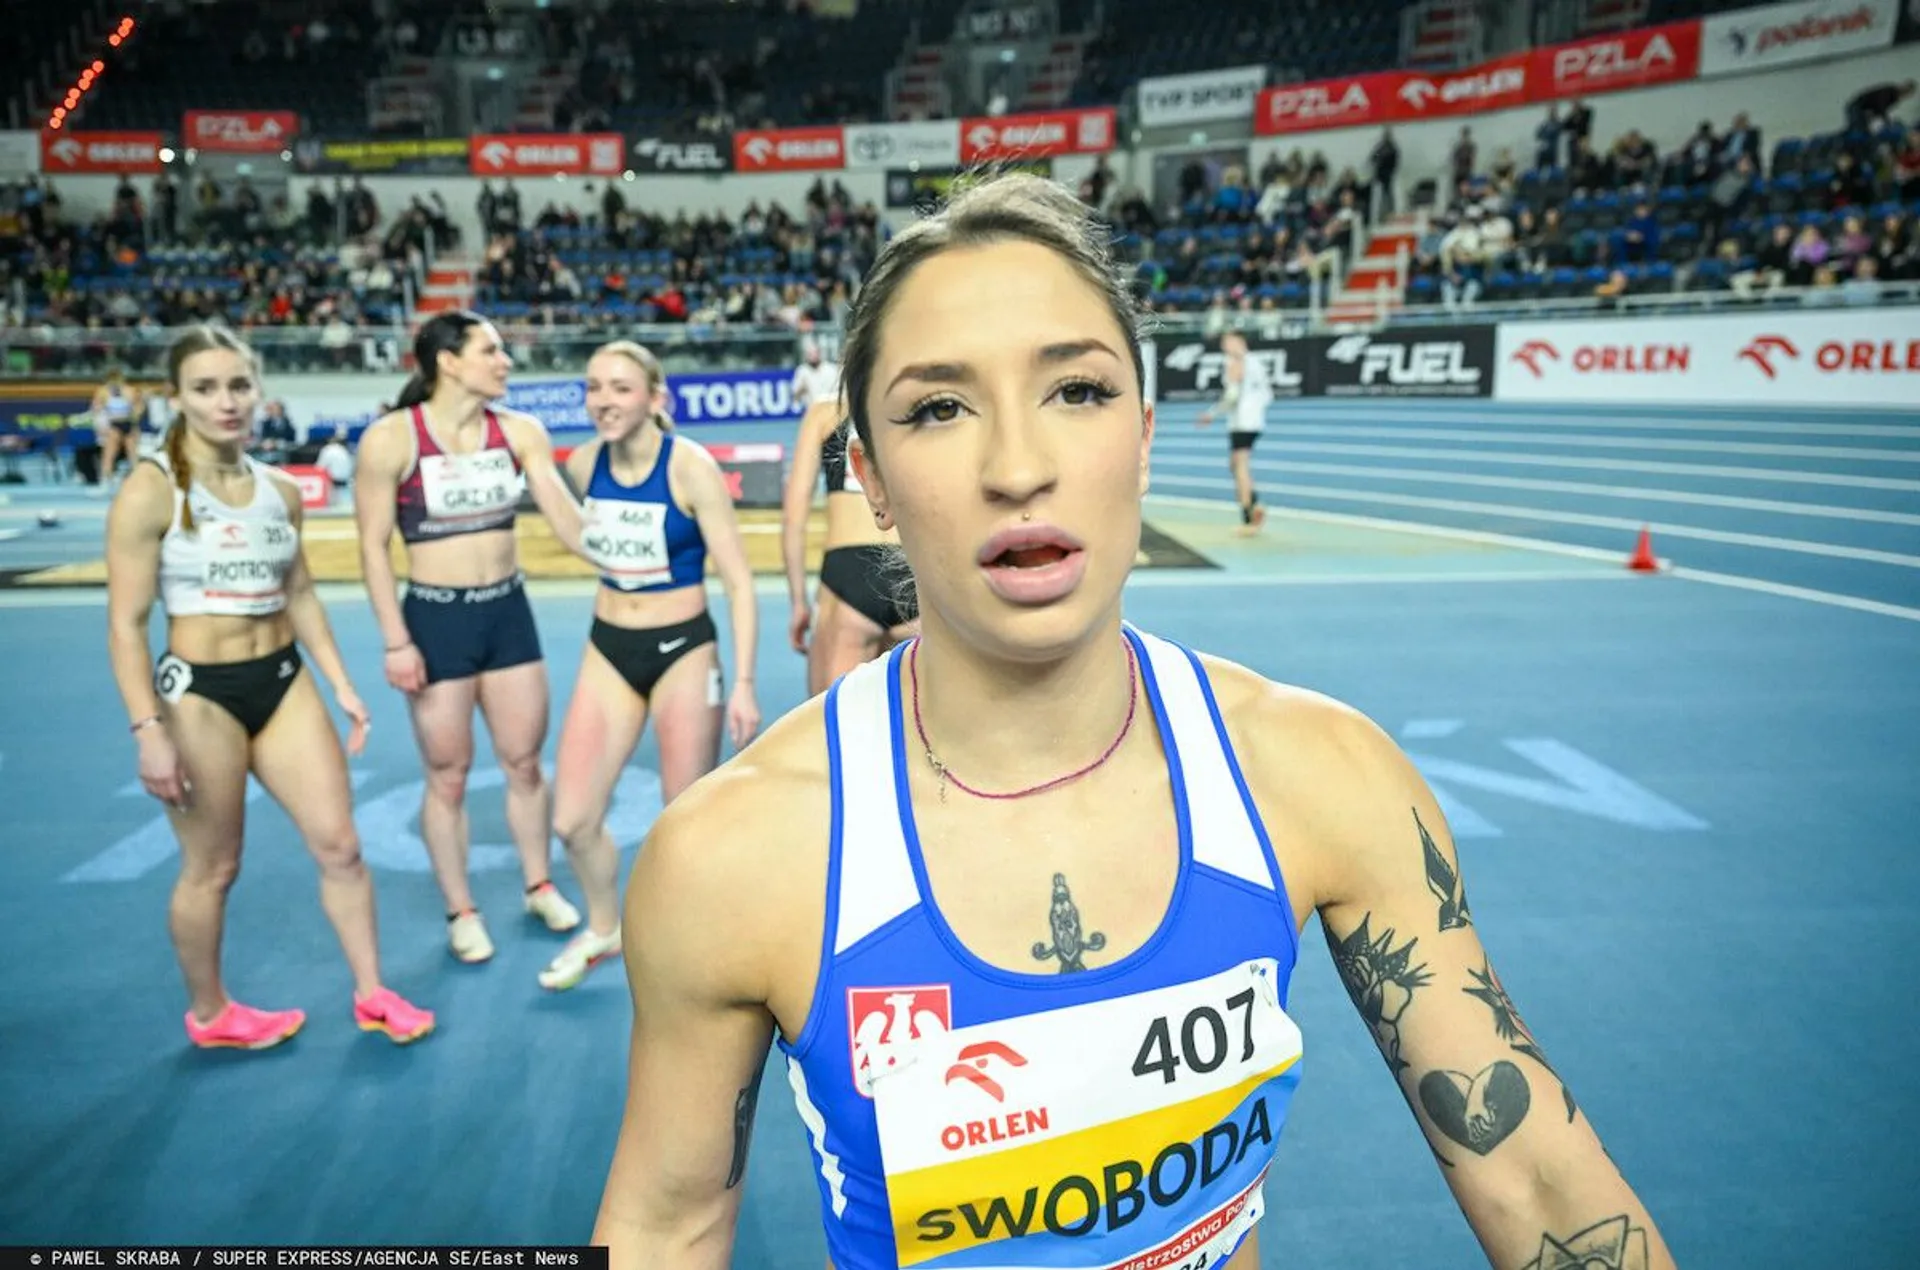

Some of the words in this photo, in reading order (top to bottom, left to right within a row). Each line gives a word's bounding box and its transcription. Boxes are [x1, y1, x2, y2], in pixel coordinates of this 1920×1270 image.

[1553, 33, 1677, 83] PZLA
[1270, 82, 1370, 120] PZLA
[1440, 67, 1526, 102] ORLEN
[513, 144, 580, 165] ORLEN
[776, 138, 840, 160] ORLEN
[1572, 344, 1692, 373] ORLEN
[678, 382, 804, 418] TORU
[160, 664, 182, 694] 6
[1131, 986, 1256, 1086] 407
[941, 1107, 1050, 1151] ORLEN
[916, 1096, 1274, 1242] SWOBODA
[1122, 1216, 1222, 1270] istrzostwa
